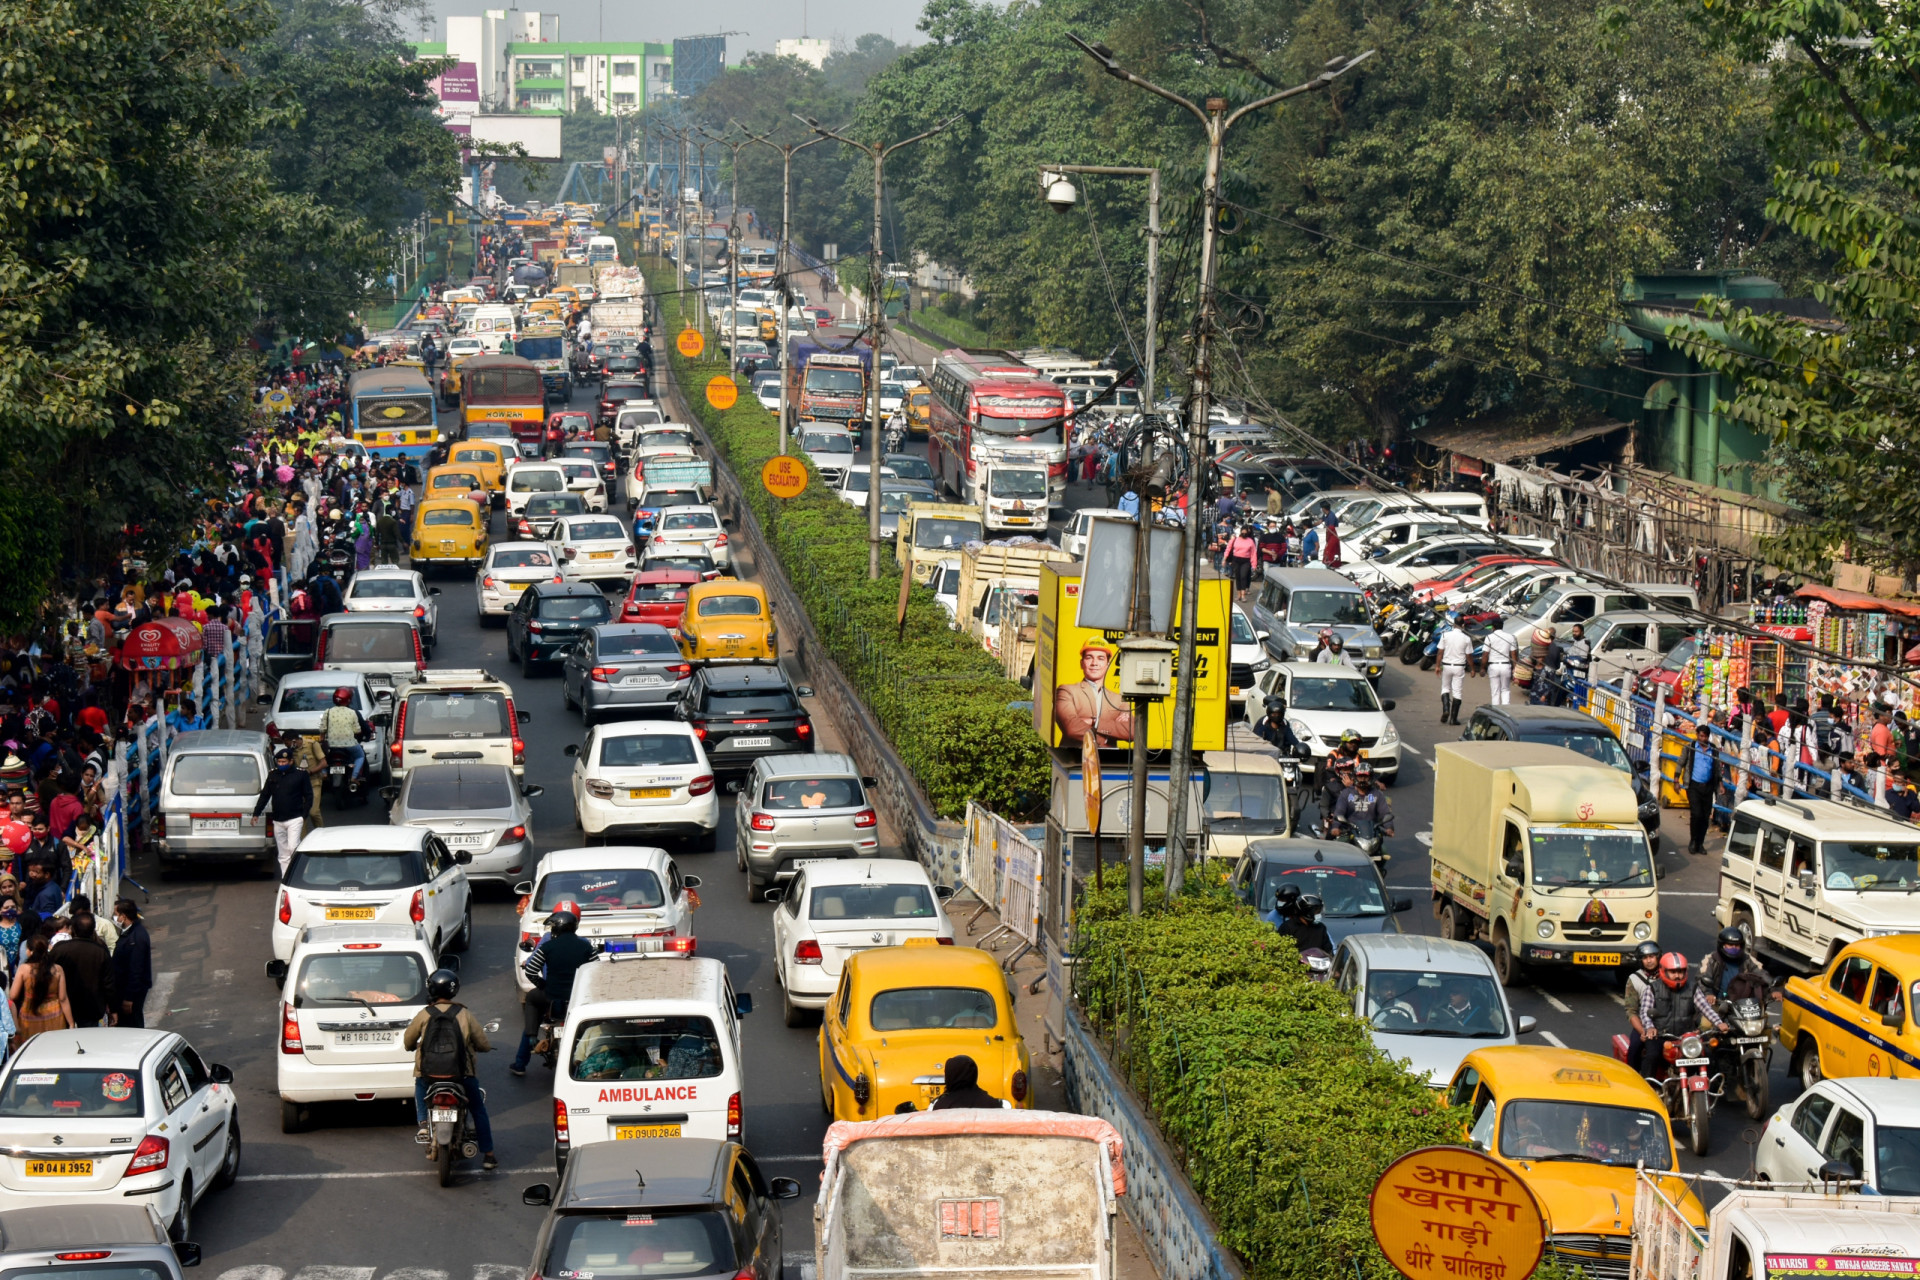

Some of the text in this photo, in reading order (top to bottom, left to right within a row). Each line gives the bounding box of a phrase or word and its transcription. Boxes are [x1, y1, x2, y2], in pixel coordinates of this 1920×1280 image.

[780, 462, 791, 473] USE
[769, 474, 800, 487] ESCALATOR
[1174, 632, 1216, 641] CENT
[770, 785, 785, 800] L
[372, 1033, 391, 1041] 1242
[1566, 1072, 1601, 1082] TAXI
[598, 1086, 697, 1102] AMBULANCE
[930, 1087, 940, 1095] WB
[623, 1128, 680, 1138] TS 09UD 2846
[33, 1163, 91, 1173] WB 04 H 3952
[1412, 1166, 1510, 1197] आगे
[1393, 1185, 1522, 1222] खतरा
[1421, 1220, 1492, 1248] गाड़ी
[1405, 1242, 1434, 1271] धीरे
[1768, 1258, 1808, 1268] YA WARISH
[1834, 1260, 1913, 1272] KHWAJA GAREEBE NAWAZ
